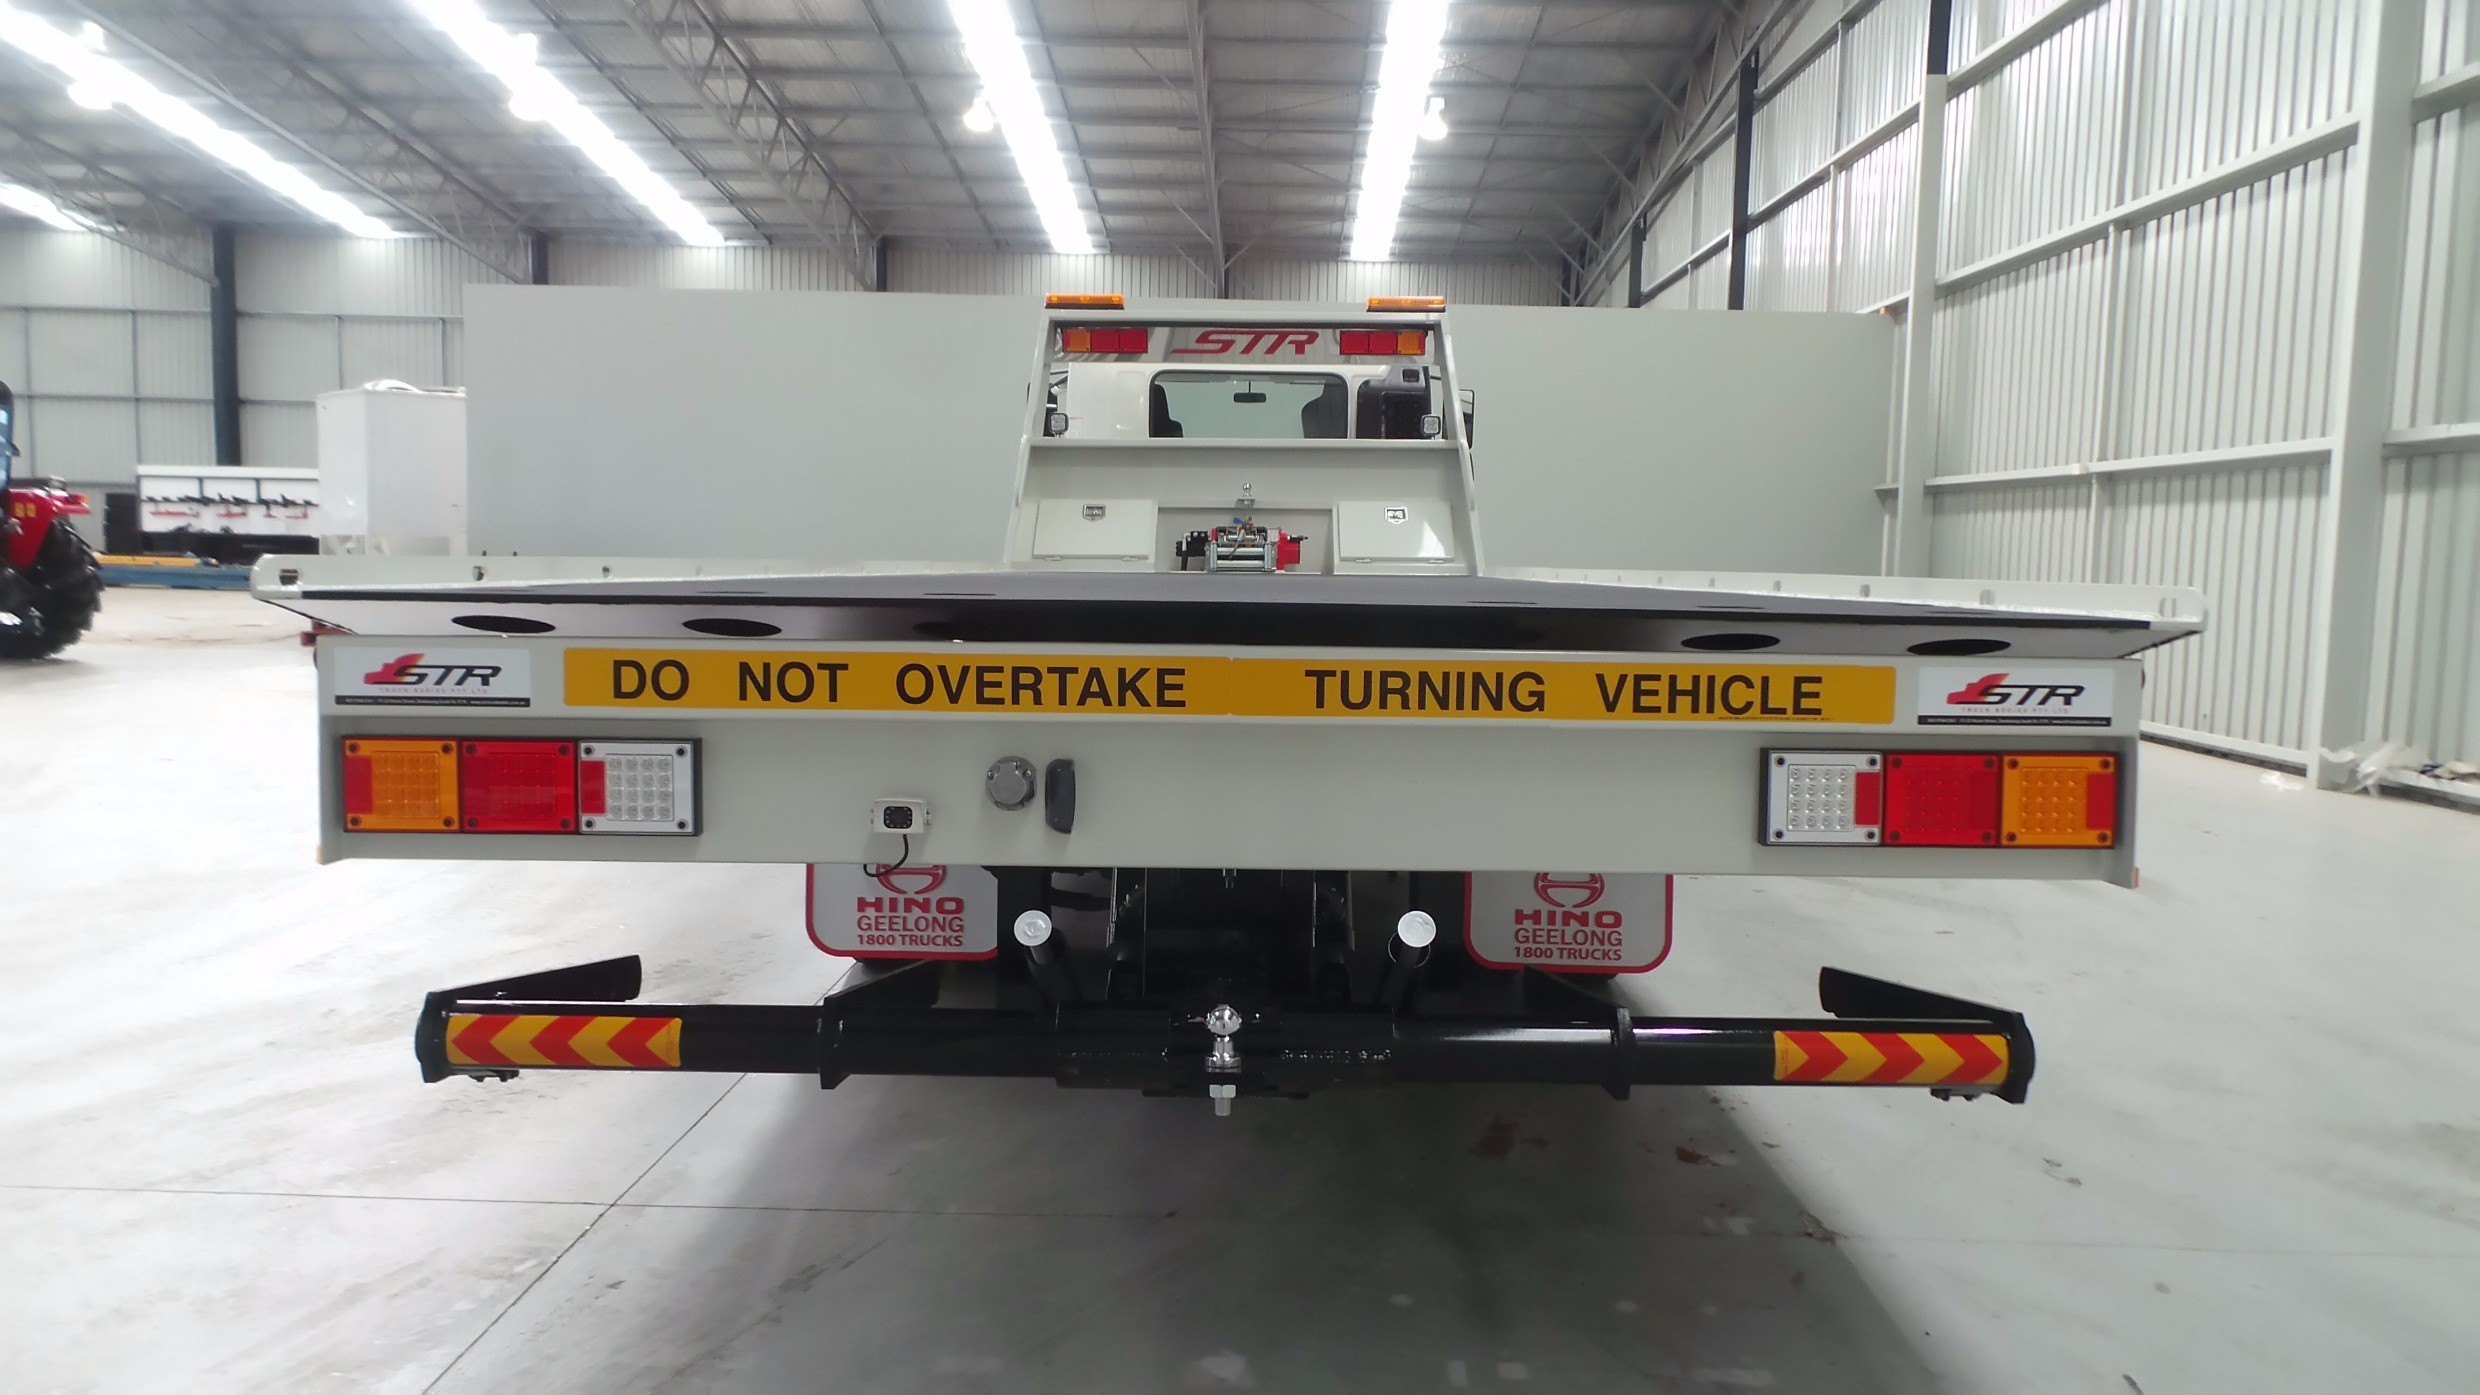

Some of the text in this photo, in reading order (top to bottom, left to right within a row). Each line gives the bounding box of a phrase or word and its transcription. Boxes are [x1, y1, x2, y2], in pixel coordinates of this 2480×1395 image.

[1171, 329, 1320, 355] STR
[372, 664, 502, 686] STR
[612, 659, 1823, 716] DO NOT OVERTAKE TURNING VEHICLE
[1955, 684, 2086, 706] STR
[857, 897, 965, 914] HINO
[857, 915, 965, 933] GEELONG
[1514, 909, 1623, 929] HINO
[857, 934, 963, 947] 1800 TRUCKS
[1514, 927, 1623, 946] GEELONG
[1514, 946, 1622, 961] 1800 TRUCKS
